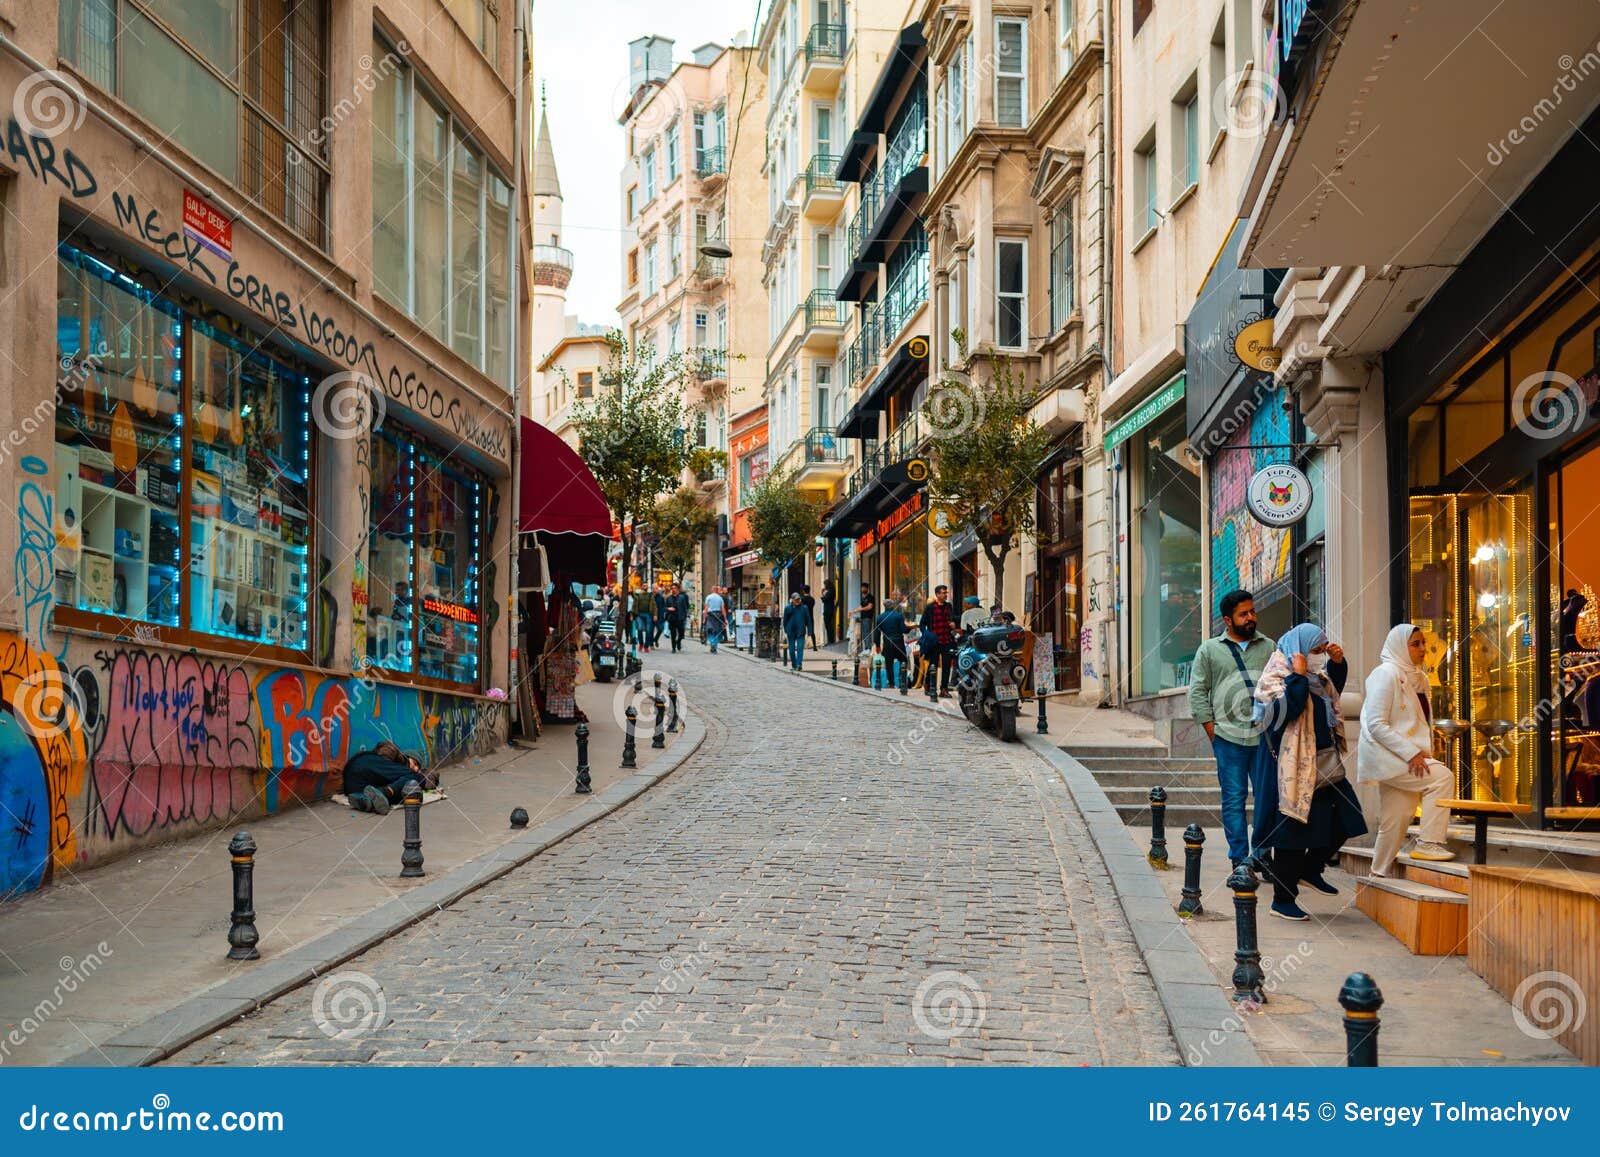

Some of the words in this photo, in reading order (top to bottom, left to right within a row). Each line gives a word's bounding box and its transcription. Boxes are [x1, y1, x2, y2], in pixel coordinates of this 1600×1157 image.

[0, 118, 97, 197] ARD
[227, 261, 297, 327] GRAB
[1137, 402, 1157, 426] RECORD
[1158, 388, 1175, 411] STORE
